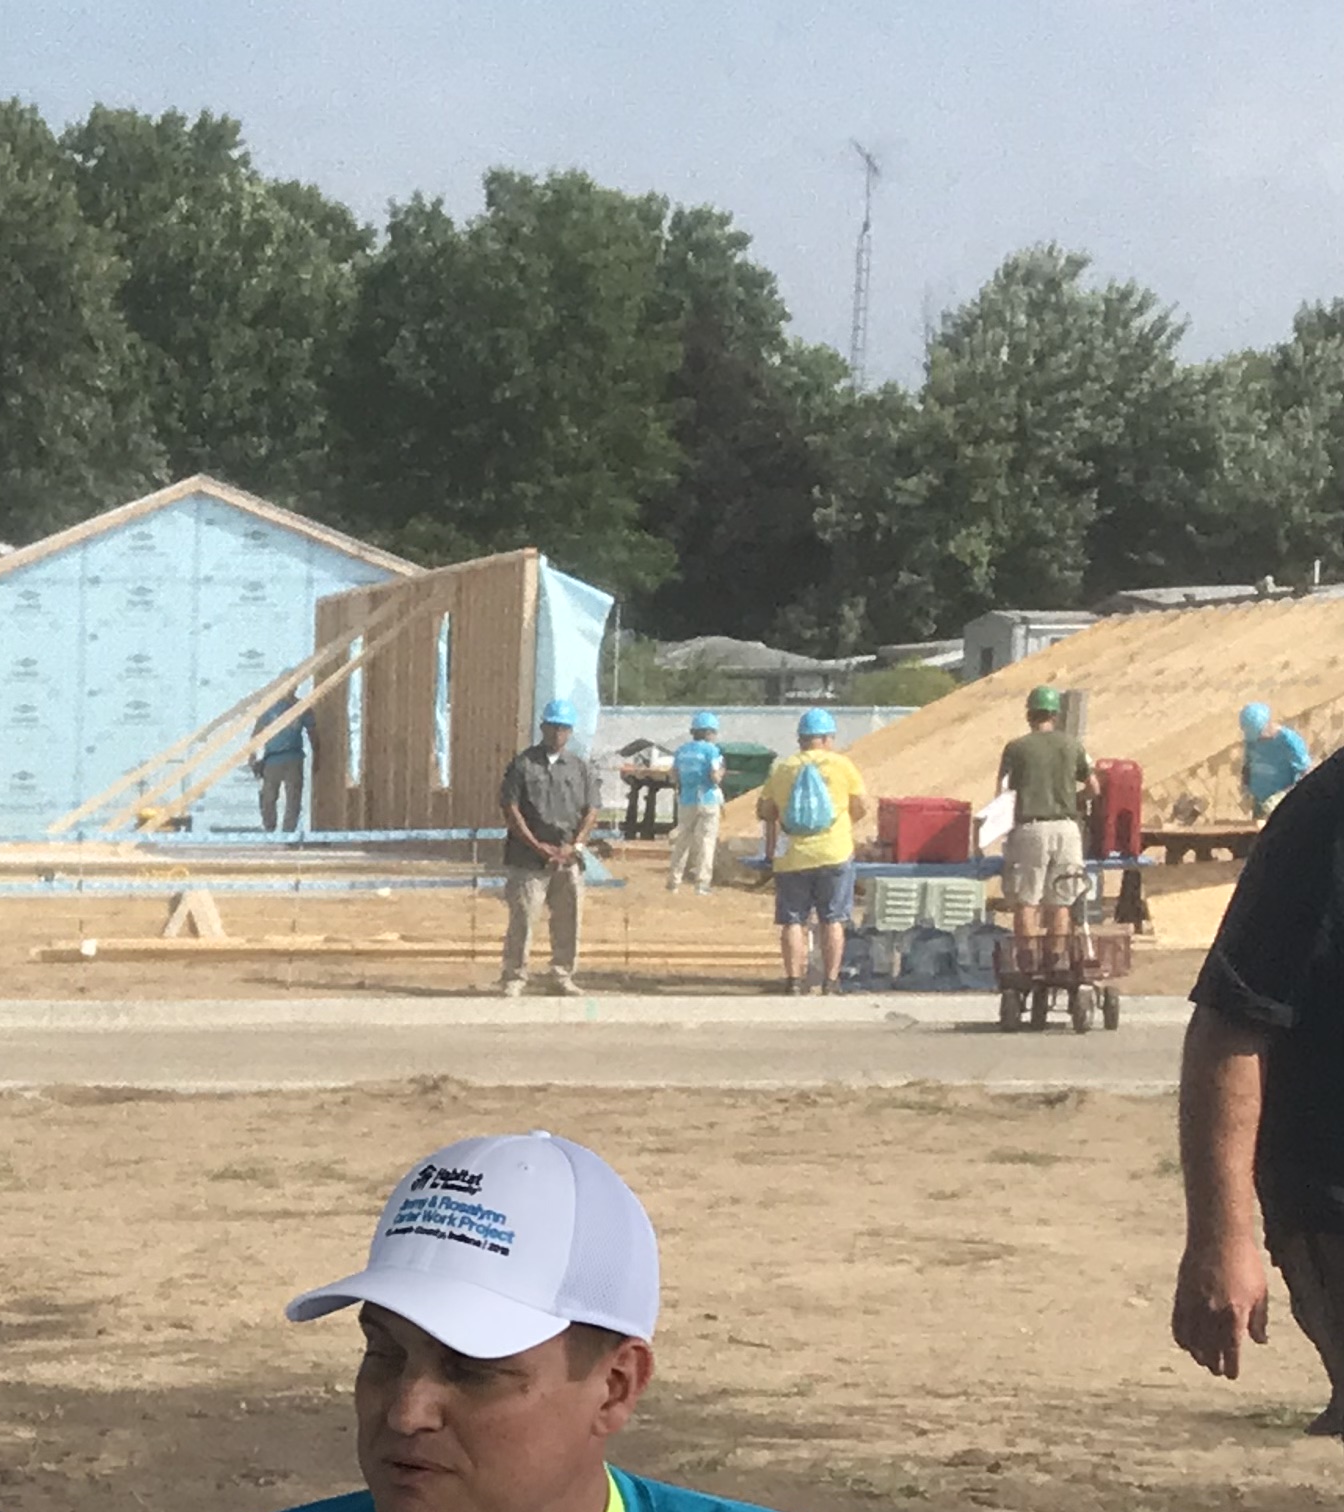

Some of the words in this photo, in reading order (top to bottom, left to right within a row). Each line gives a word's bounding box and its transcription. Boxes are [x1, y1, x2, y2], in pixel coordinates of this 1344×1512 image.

[434, 1168, 483, 1186] Habitat
[438, 1196, 507, 1225] Rosalynn
[422, 1210, 457, 1227] Work
[458, 1216, 515, 1244] Project
